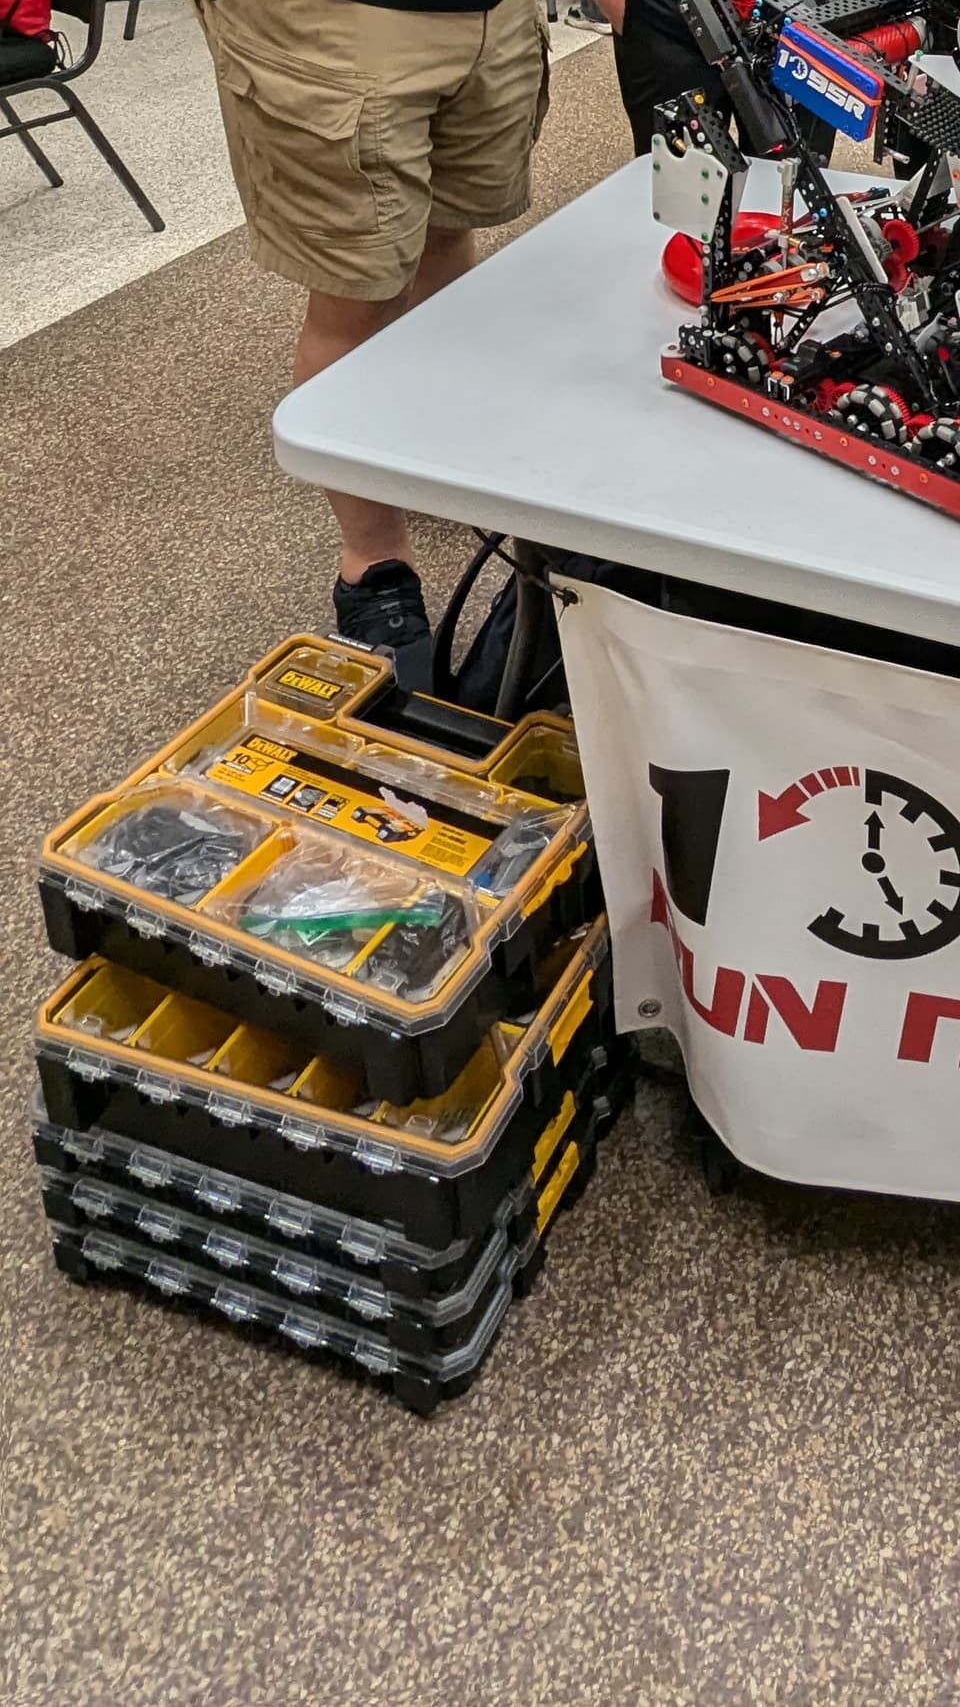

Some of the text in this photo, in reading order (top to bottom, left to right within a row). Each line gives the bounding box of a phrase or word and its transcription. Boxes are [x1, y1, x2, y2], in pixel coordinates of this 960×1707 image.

[777, 48, 866, 121] 1095R
[232, 752, 251, 765] 10
[651, 867, 848, 1053] UN
